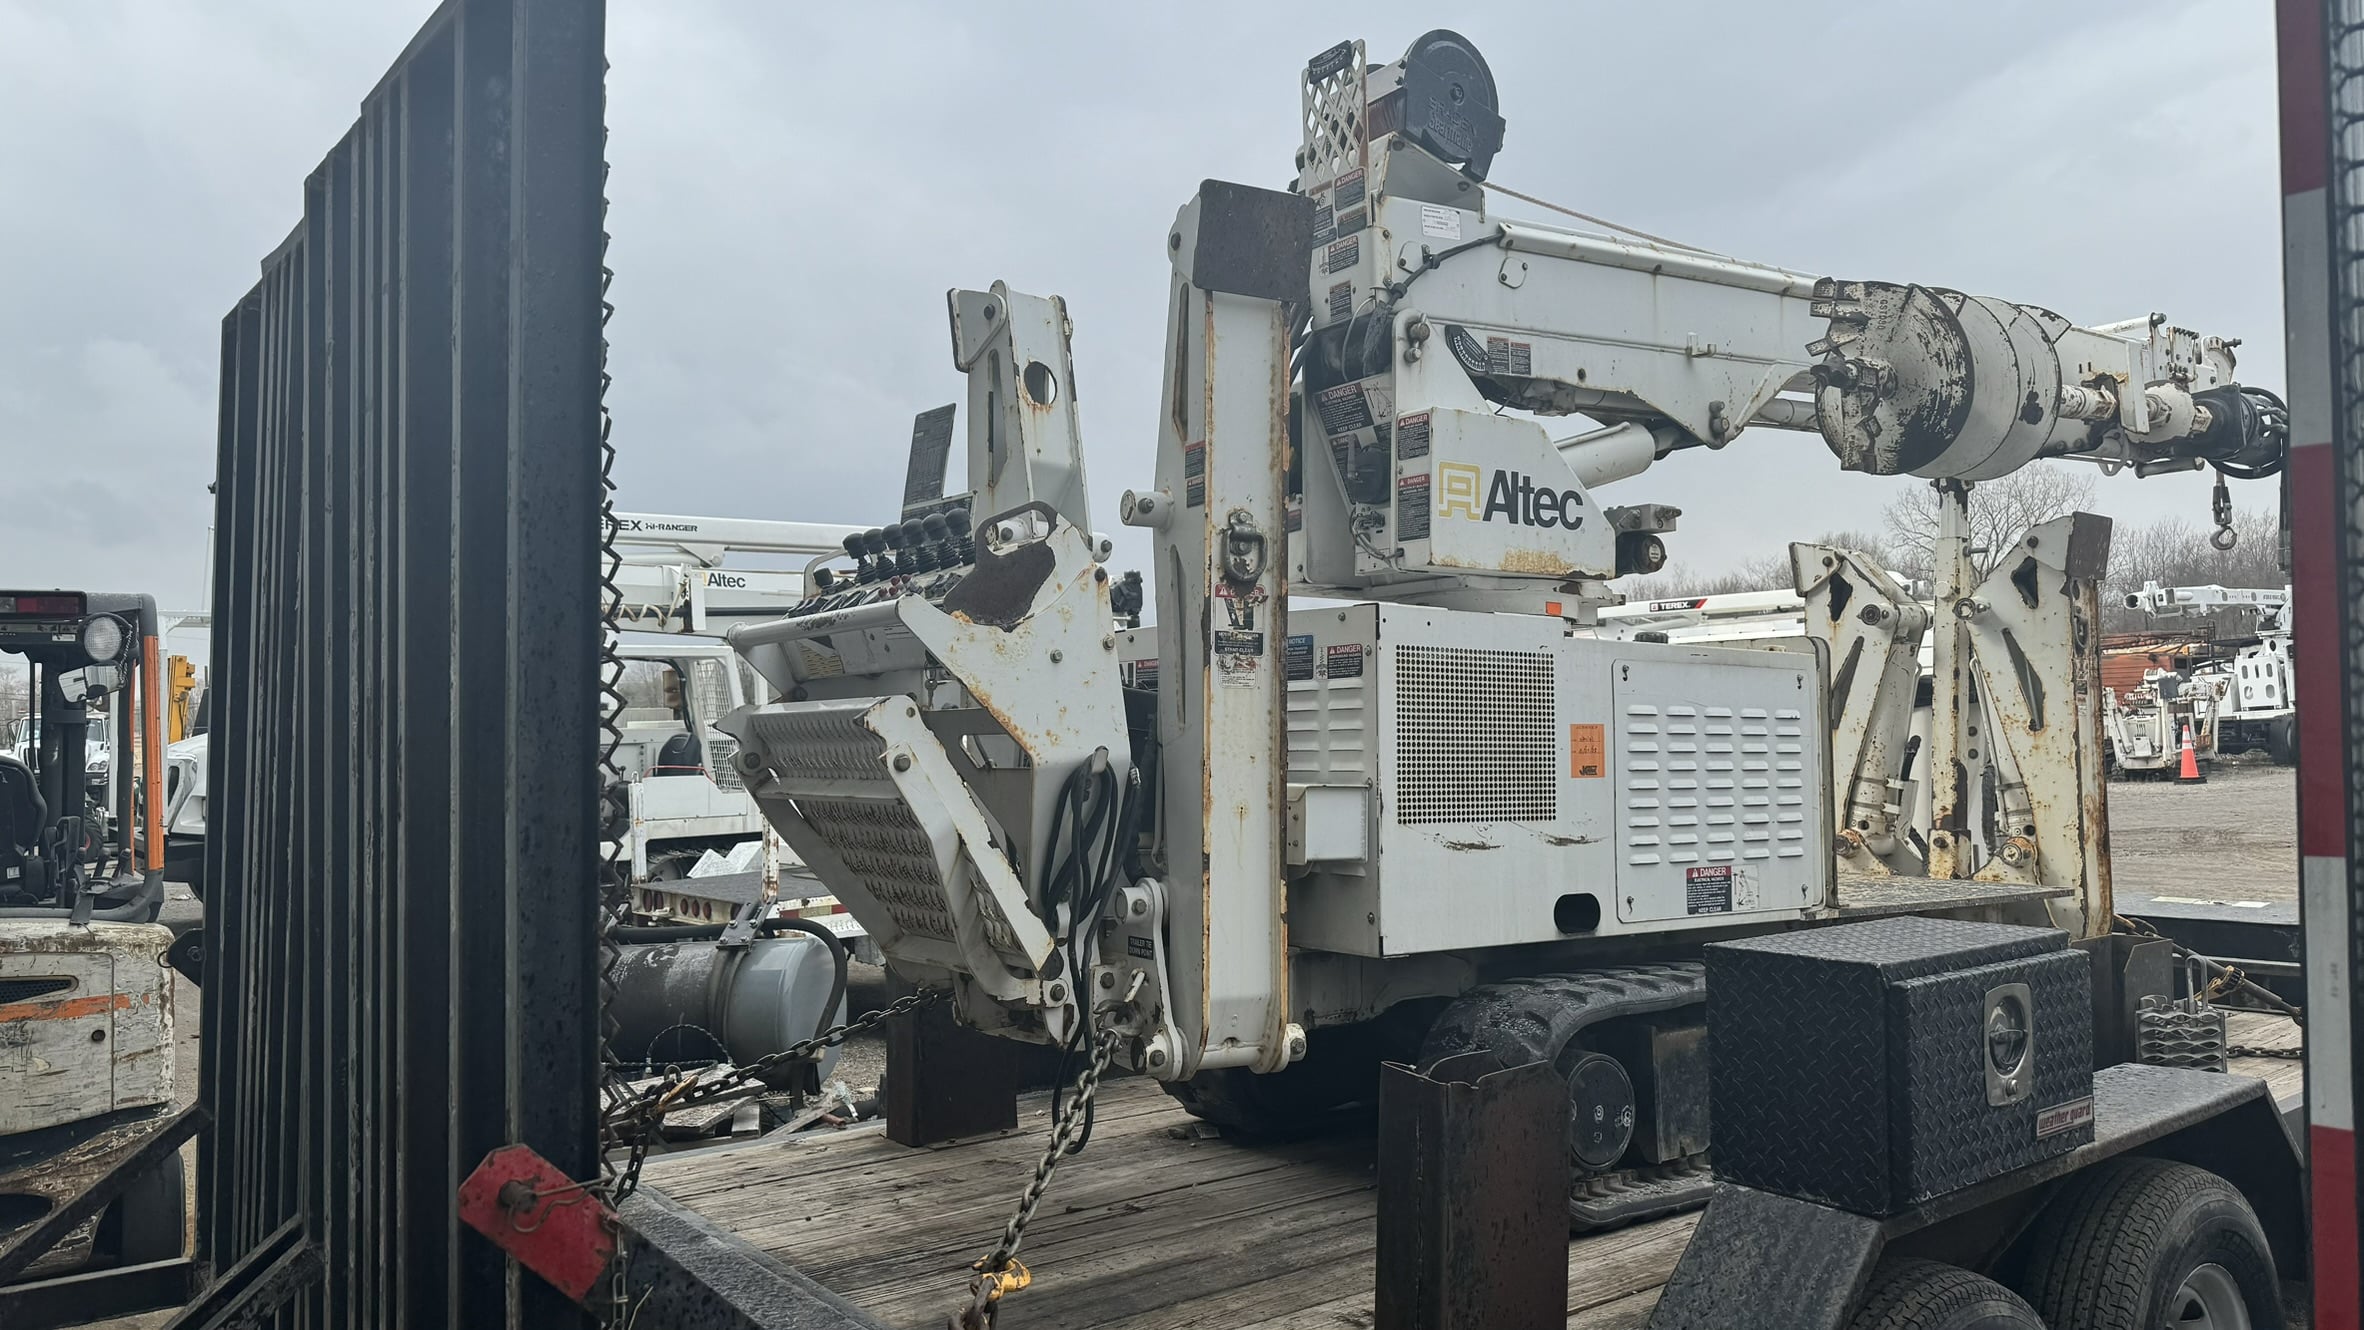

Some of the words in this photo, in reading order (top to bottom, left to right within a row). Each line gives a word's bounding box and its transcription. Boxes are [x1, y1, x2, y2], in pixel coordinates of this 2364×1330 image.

[1335, 235, 1358, 250] DANGER
[1327, 385, 1357, 400] DANGER
[1404, 414, 1428, 426] DANGER
[1482, 469, 1583, 531] Altec
[707, 572, 746, 588] Altec
[1660, 601, 1689, 610] TEREX
[1336, 644, 1361, 654] DANGER
[1700, 867, 1727, 877] DANGER
[2039, 1110, 2069, 1129] weather
[2069, 1102, 2091, 1124] guard
